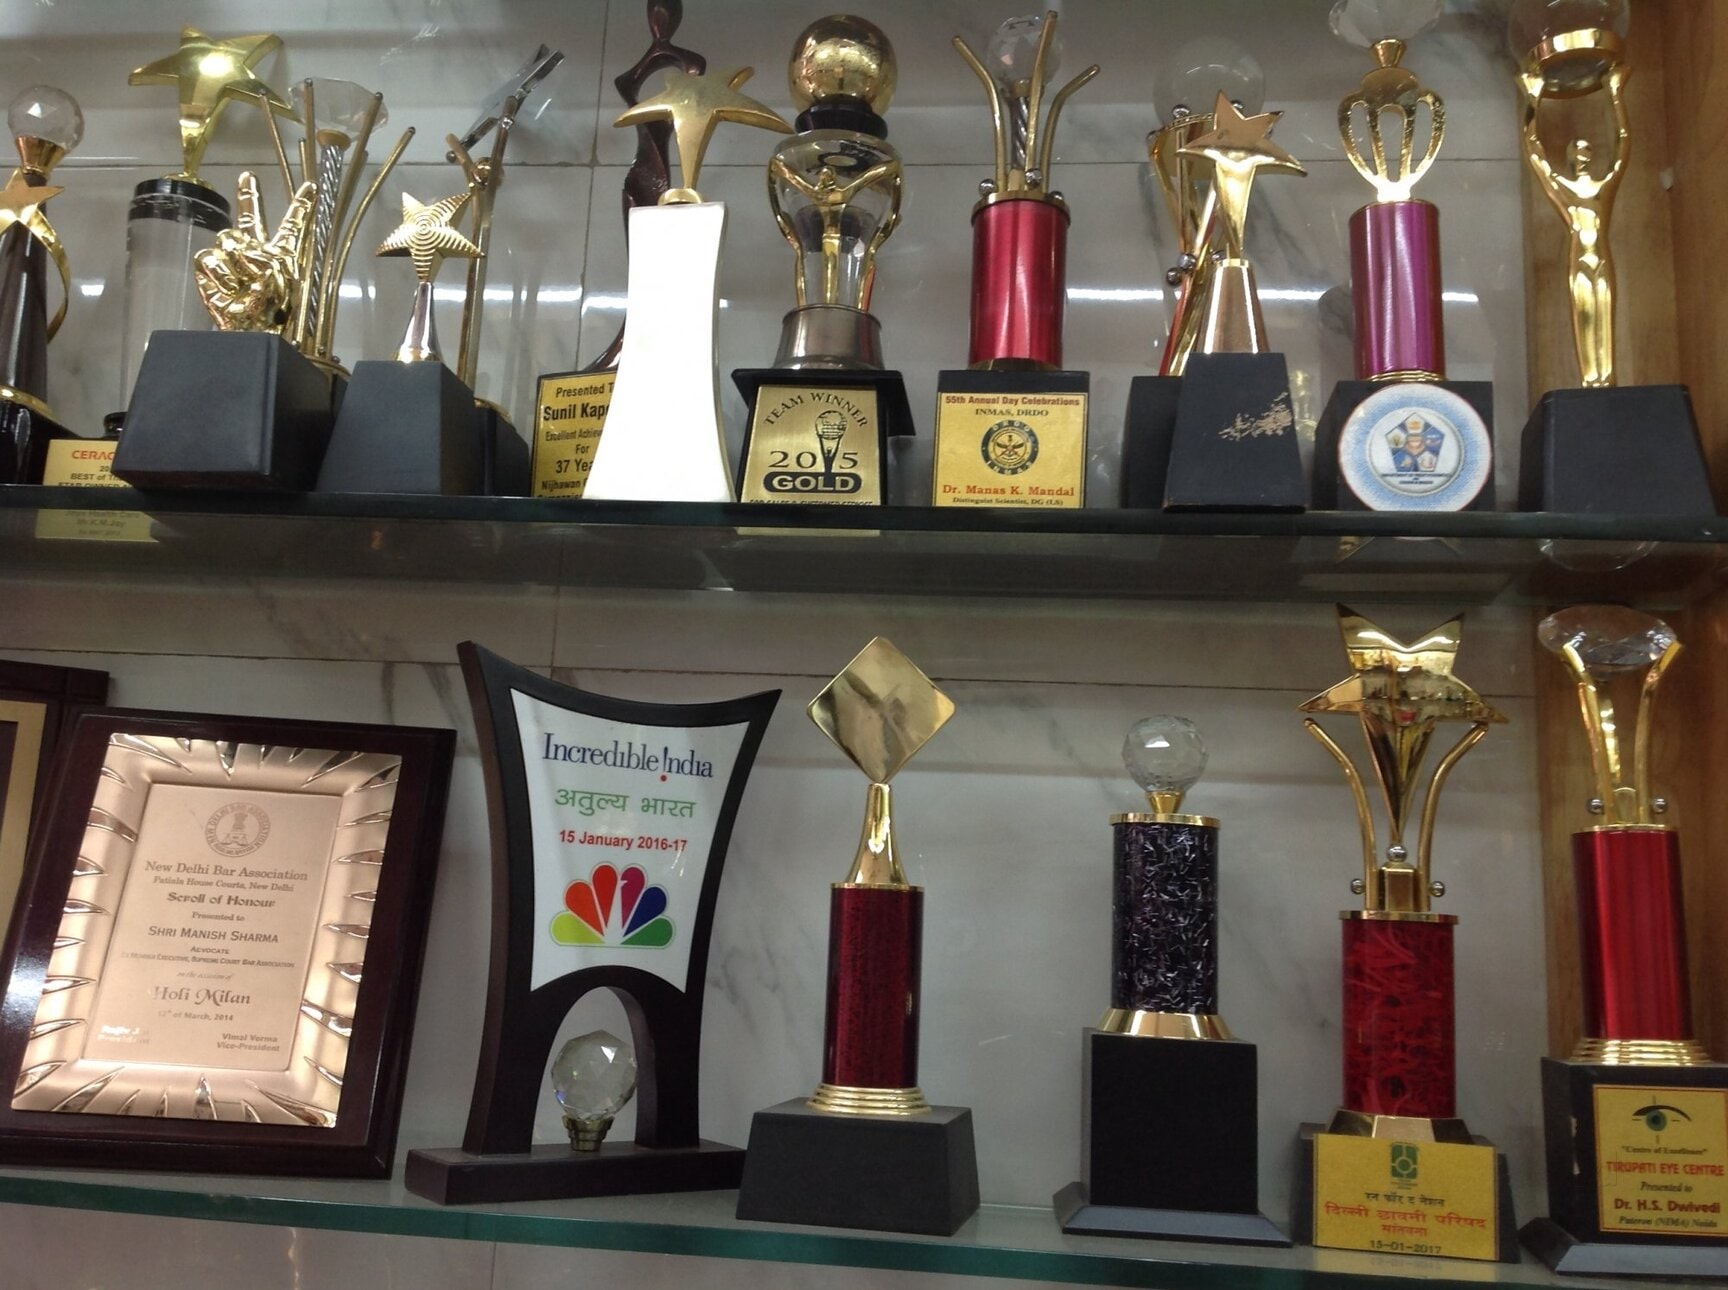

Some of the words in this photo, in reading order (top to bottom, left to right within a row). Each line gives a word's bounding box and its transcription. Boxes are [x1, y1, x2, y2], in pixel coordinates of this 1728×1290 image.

[556, 384, 604, 398] Presented
[946, 396, 965, 404] 55th
[1002, 397, 1018, 406] Day
[1021, 397, 1080, 406] Celebrations
[544, 405, 577, 421] Sunil
[581, 403, 609, 420] Kap
[764, 395, 804, 426] TEAM
[811, 392, 867, 427] WINNER
[576, 445, 589, 454] For
[556, 460, 570, 473] 37
[772, 475, 854, 491] GOLD
[943, 485, 960, 493] Dr.
[966, 486, 1005, 494] Manas
[1010, 486, 1023, 494] K.
[1028, 487, 1074, 496] Mandal
[543, 733, 659, 771] Incredible
[555, 789, 629, 816] अतुल्य
[641, 797, 696, 818] भारत
[560, 830, 575, 843] 15
[579, 832, 633, 850] January
[638, 837, 687, 851] 2016-17
[145, 861, 172, 872] New
[176, 862, 209, 875] Delhi
[213, 865, 236, 877] Bar
[238, 866, 308, 881] Association
[186, 878, 213, 887] House
[216, 880, 247, 890] Courts,
[249, 882, 269, 890] New
[271, 883, 294, 892] Delhi
[167, 892, 206, 904] Scroll
[209, 893, 222, 904] of
[226, 895, 276, 908] Honour
[192, 911, 233, 921] Presented
[148, 925, 177, 937] SHRI
[180, 927, 227, 941] MANISH
[230, 930, 279, 943] SHARMA
[154, 986, 191, 1000] Holi
[195, 988, 251, 1006] Milan
[184, 1012, 211, 1020] March,
[222, 1033, 247, 1041] Vimal
[250, 1034, 278, 1042] Verma
[217, 1042, 280, 1052] Vice-President
[1606, 1161, 1656, 1174] TIRUPATI
[1659, 1163, 1679, 1174] EYE
[1683, 1164, 1724, 1176] CENTRE
[1641, 1181, 1682, 1192] Presented
[1614, 1199, 1632, 1210] Dr.
[1637, 1200, 1663, 1211] H.S.
[1668, 1200, 1720, 1213] Dwivedi
[1325, 1201, 1369, 1217] दिल्ली
[1435, 1212, 1487, 1228] परिषद
[1370, 1240, 1441, 1254] 15-01-2017
